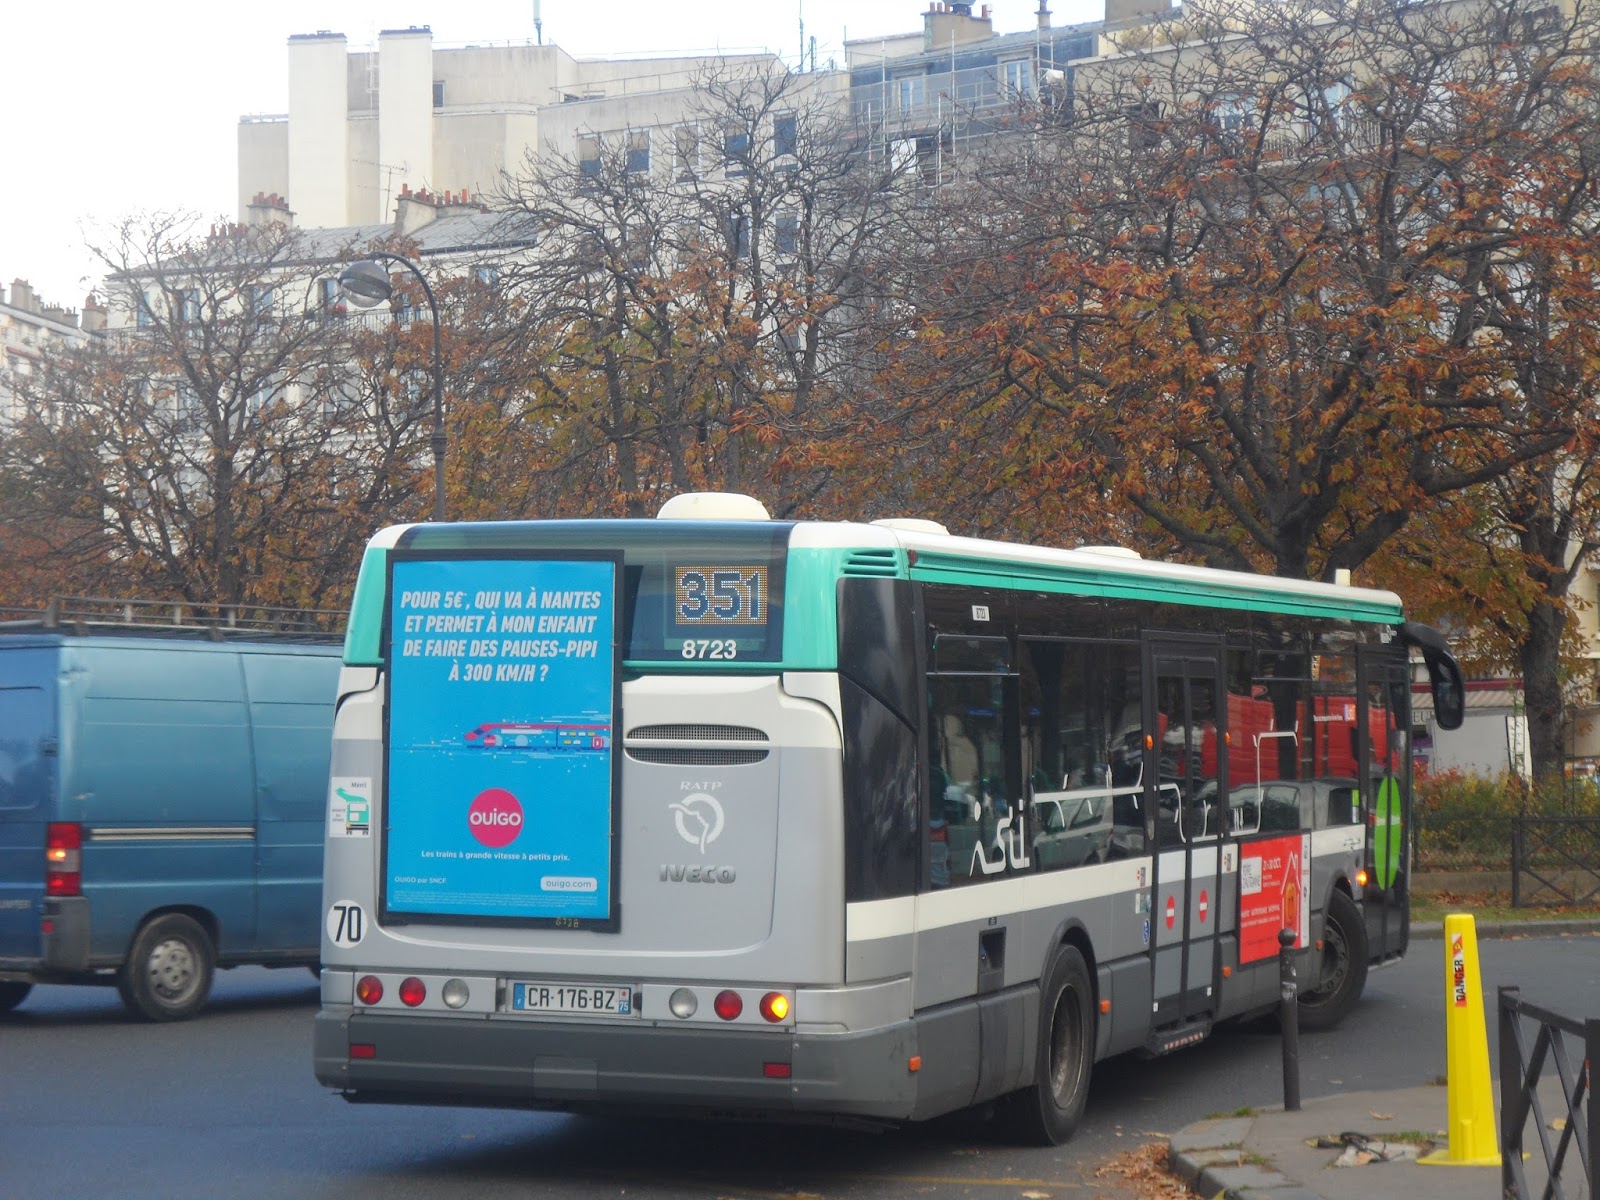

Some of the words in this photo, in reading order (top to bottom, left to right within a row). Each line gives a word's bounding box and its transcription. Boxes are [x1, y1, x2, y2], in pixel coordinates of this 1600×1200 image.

[401, 591, 441, 609] POUR
[474, 591, 500, 609] QUI
[505, 591, 522, 608] VA
[526, 587, 537, 609] À
[541, 591, 601, 609] NANTES
[680, 570, 760, 620] 351
[404, 615, 423, 633] ET
[425, 615, 484, 633] PERMET
[486, 611, 497, 633] À
[501, 615, 536, 633] MON
[537, 615, 597, 633] ENFANT
[403, 639, 422, 657] DE
[424, 639, 468, 657] FAIRE
[469, 640, 499, 657] DES
[501, 640, 598, 658] PAUSES-PIPI
[681, 639, 737, 659] 8723
[448, 659, 459, 681] À
[463, 664, 493, 681] 300
[495, 664, 536, 682] KM/H
[540, 664, 549, 682] ?
[680, 781, 722, 791] RATP
[436, 851, 457, 859] trains
[465, 851, 492, 860] grande
[494, 852, 520, 860] vitesse
[528, 853, 551, 861] petits
[553, 853, 570, 861] prix.
[546, 879, 592, 889] ouigo.com
[659, 864, 736, 884] IVECO
[333, 906, 362, 942] 70
[1454, 960, 1466, 1001] DANGER
[619, 1002, 629, 1011] 75
